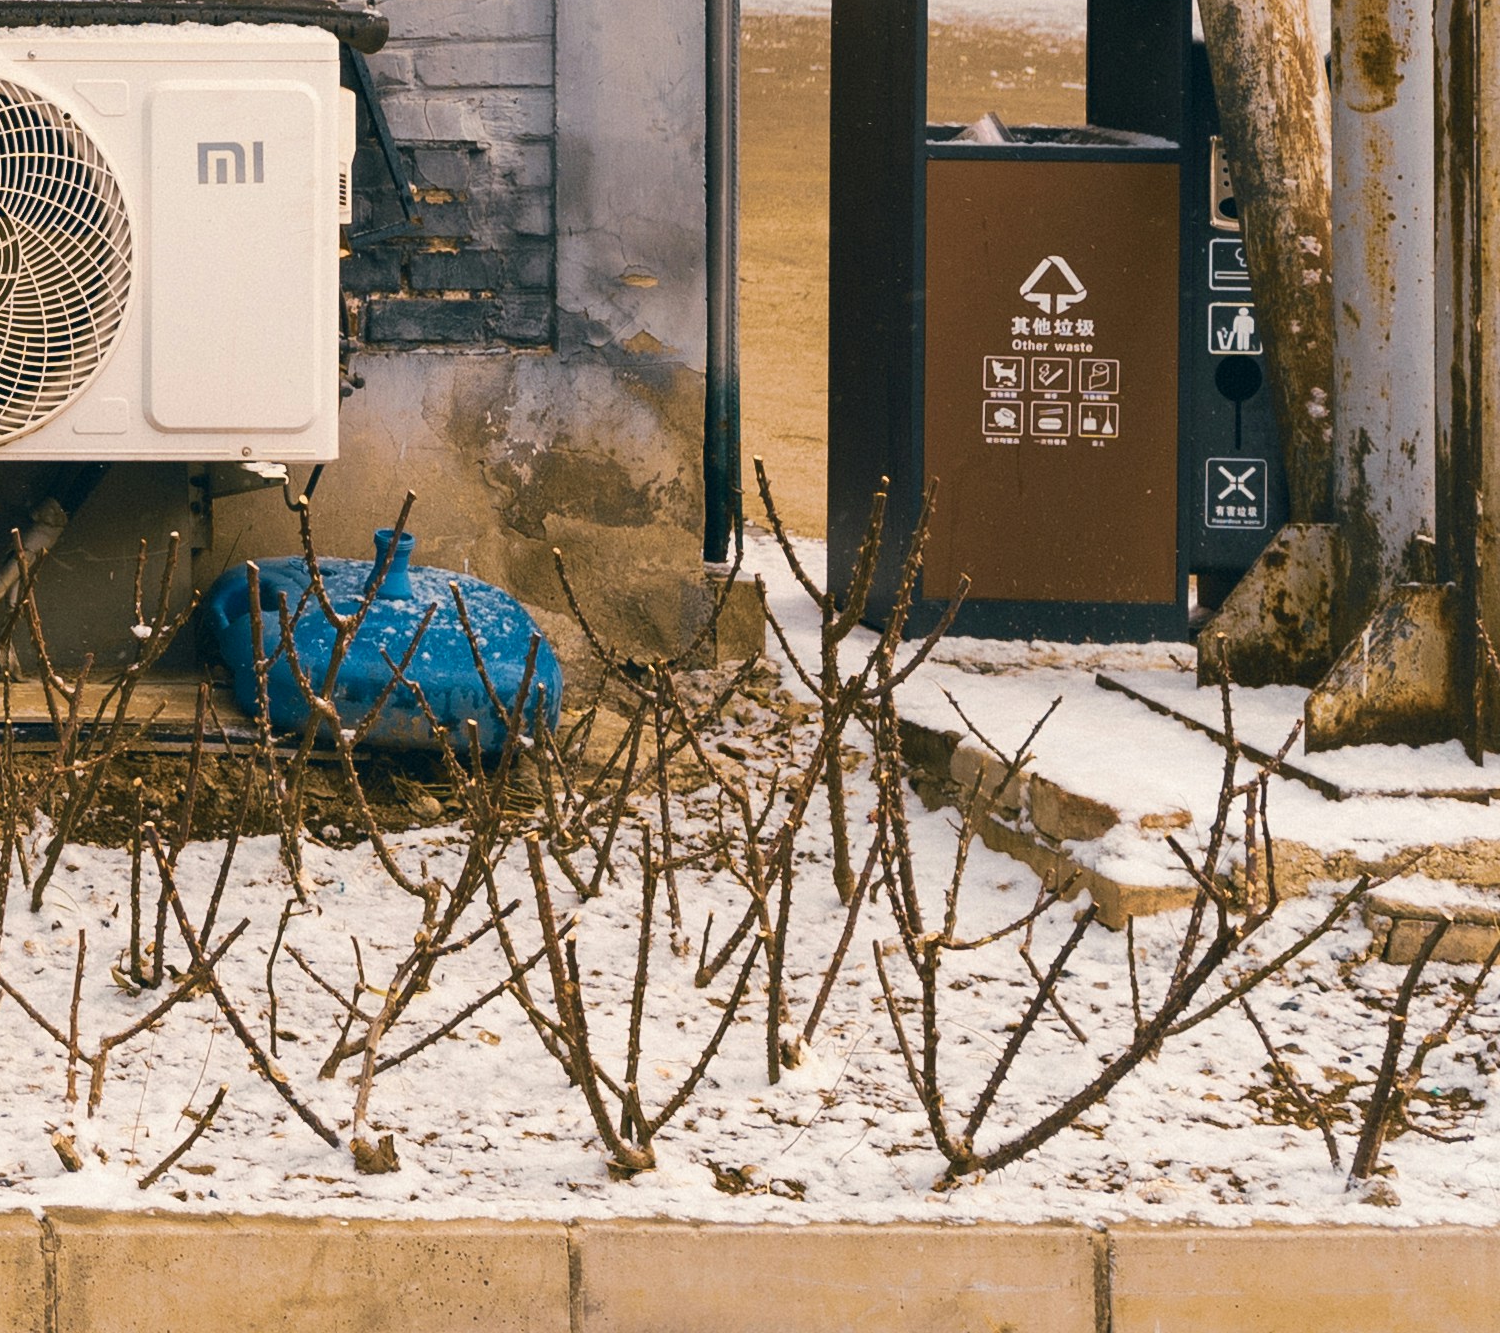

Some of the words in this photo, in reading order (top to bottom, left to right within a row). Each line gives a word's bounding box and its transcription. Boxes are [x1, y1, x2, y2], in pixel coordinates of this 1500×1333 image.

[1011, 316, 1095, 337] 其他垃圾
[1012, 339, 1048, 351] Other
[1054, 341, 1093, 352] waste
